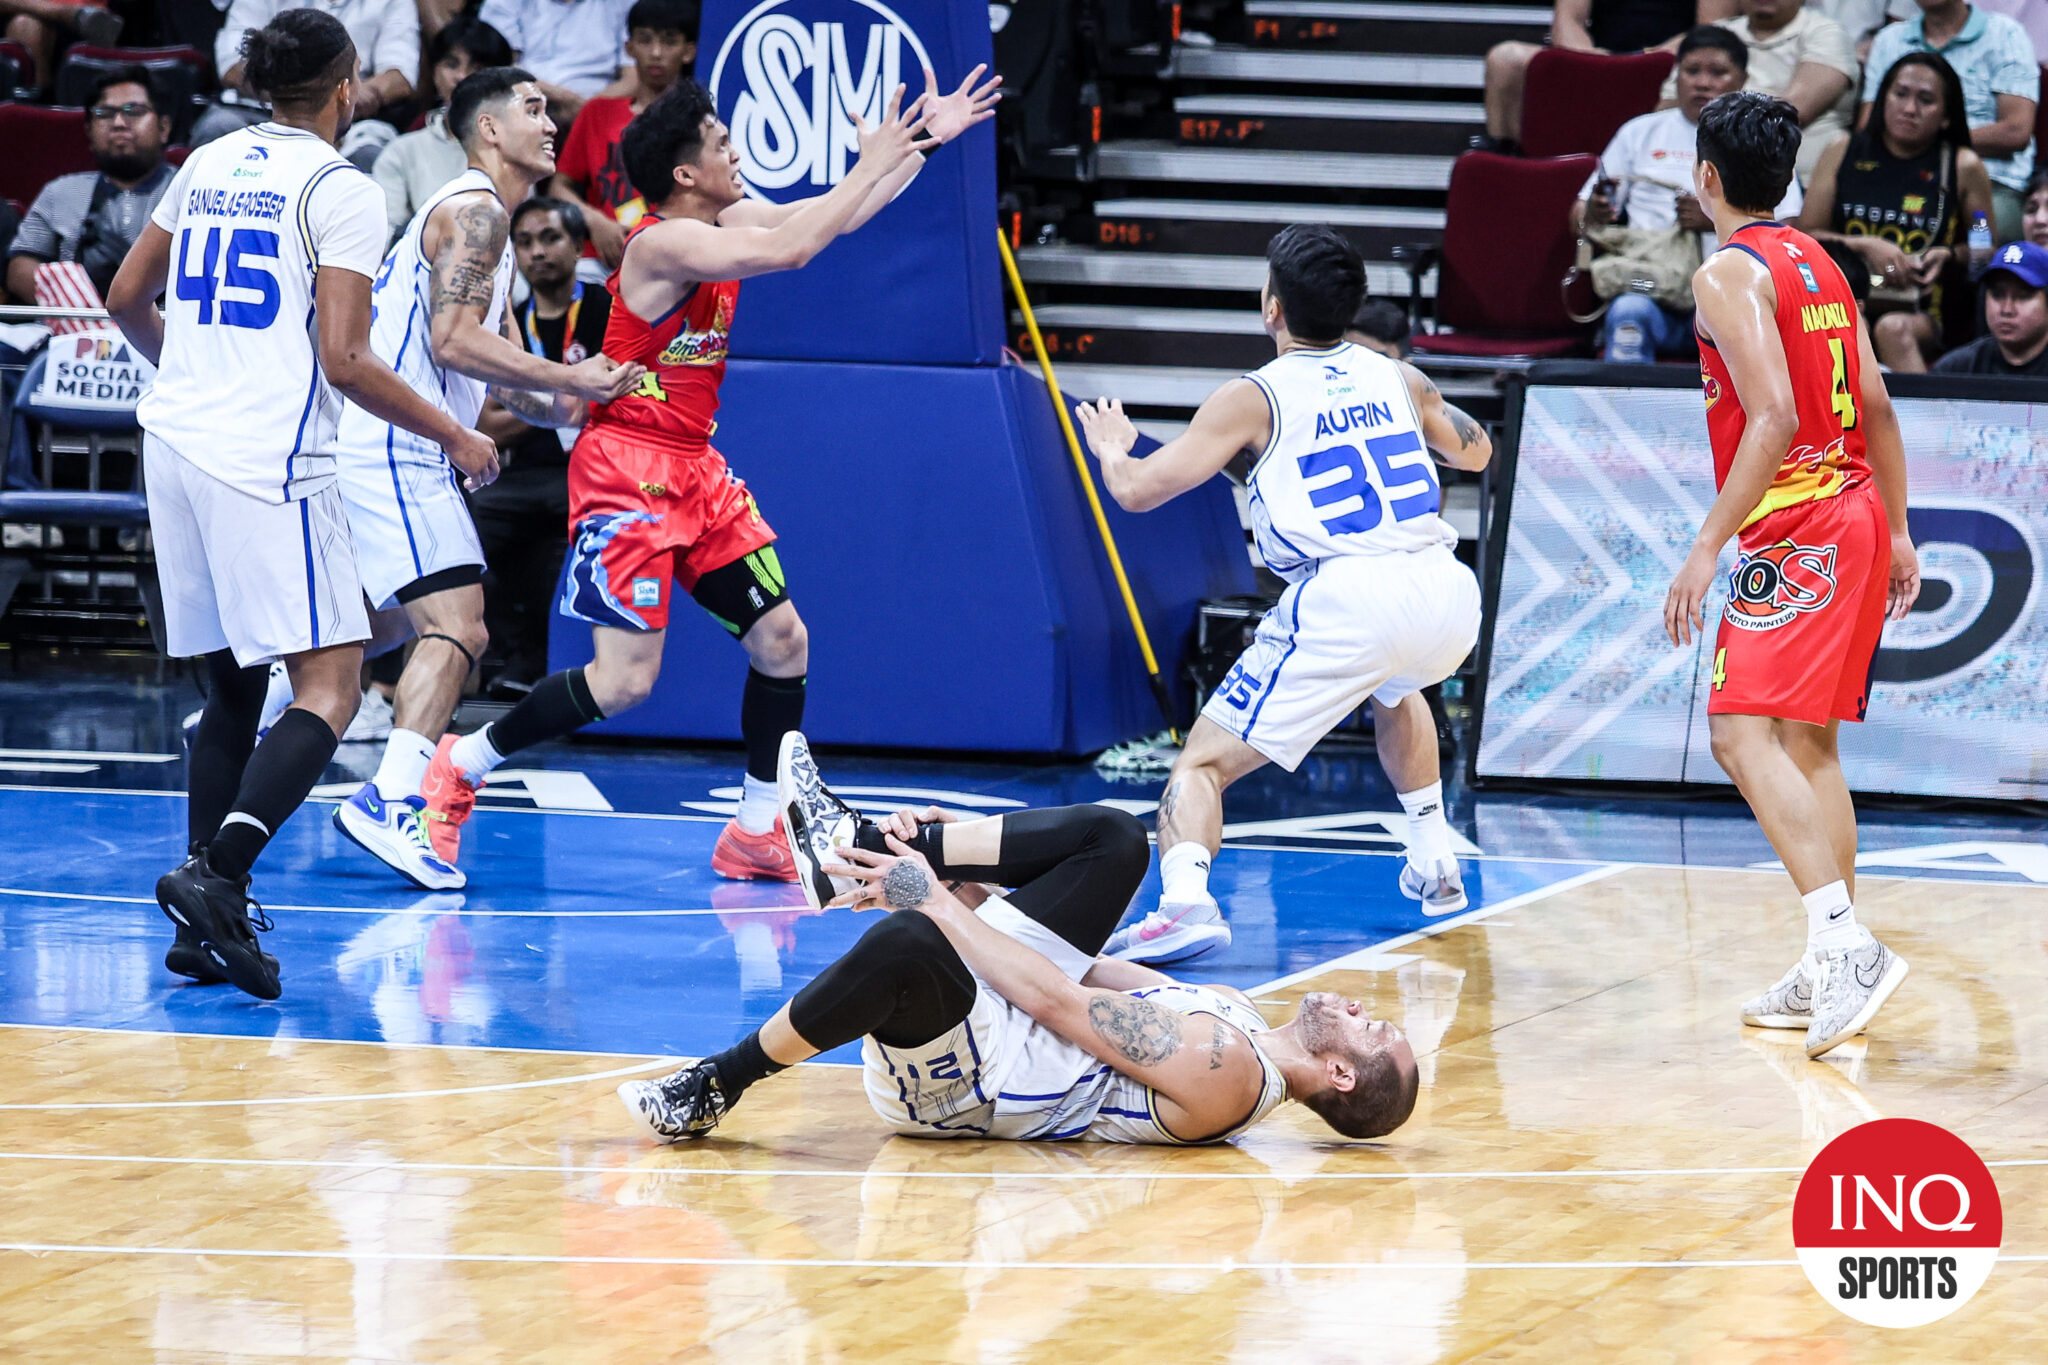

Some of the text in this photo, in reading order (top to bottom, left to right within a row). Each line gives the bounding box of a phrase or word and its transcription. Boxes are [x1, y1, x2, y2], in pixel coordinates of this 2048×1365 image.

[729, 13, 901, 190] SM
[176, 227, 281, 330] 45
[56, 380, 140, 400] MEDIA
[58, 362, 144, 384] SOCIAL
[1827, 337, 1857, 431] 4
[1315, 402, 1394, 440] AURIN
[1297, 431, 1441, 537] 35
[1750, 611, 1796, 629] PAINTERS
[1216, 663, 1262, 710] 35
[1712, 647, 1727, 691] 4
